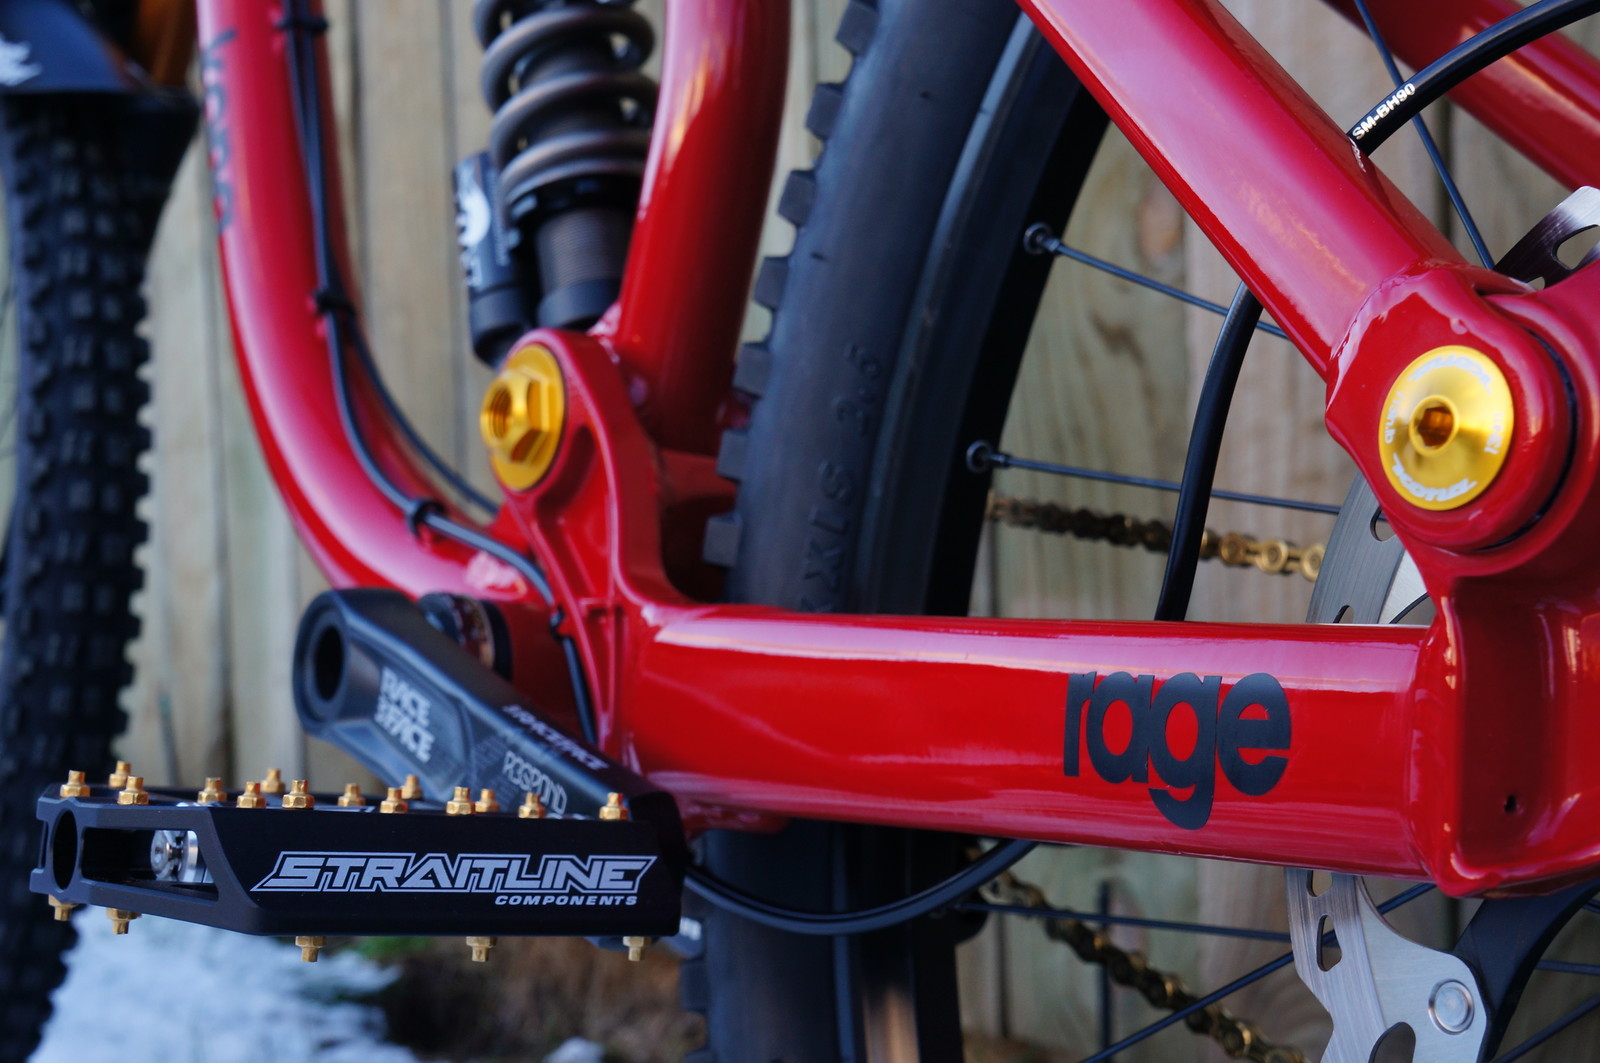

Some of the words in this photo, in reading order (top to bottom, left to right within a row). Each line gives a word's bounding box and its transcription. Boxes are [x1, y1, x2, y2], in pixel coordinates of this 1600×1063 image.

[1352, 83, 1416, 140] SM-BH90
[1063, 671, 1292, 830] rage
[251, 851, 657, 893] STRAITLINE
[494, 895, 638, 906] COMPONENTS
